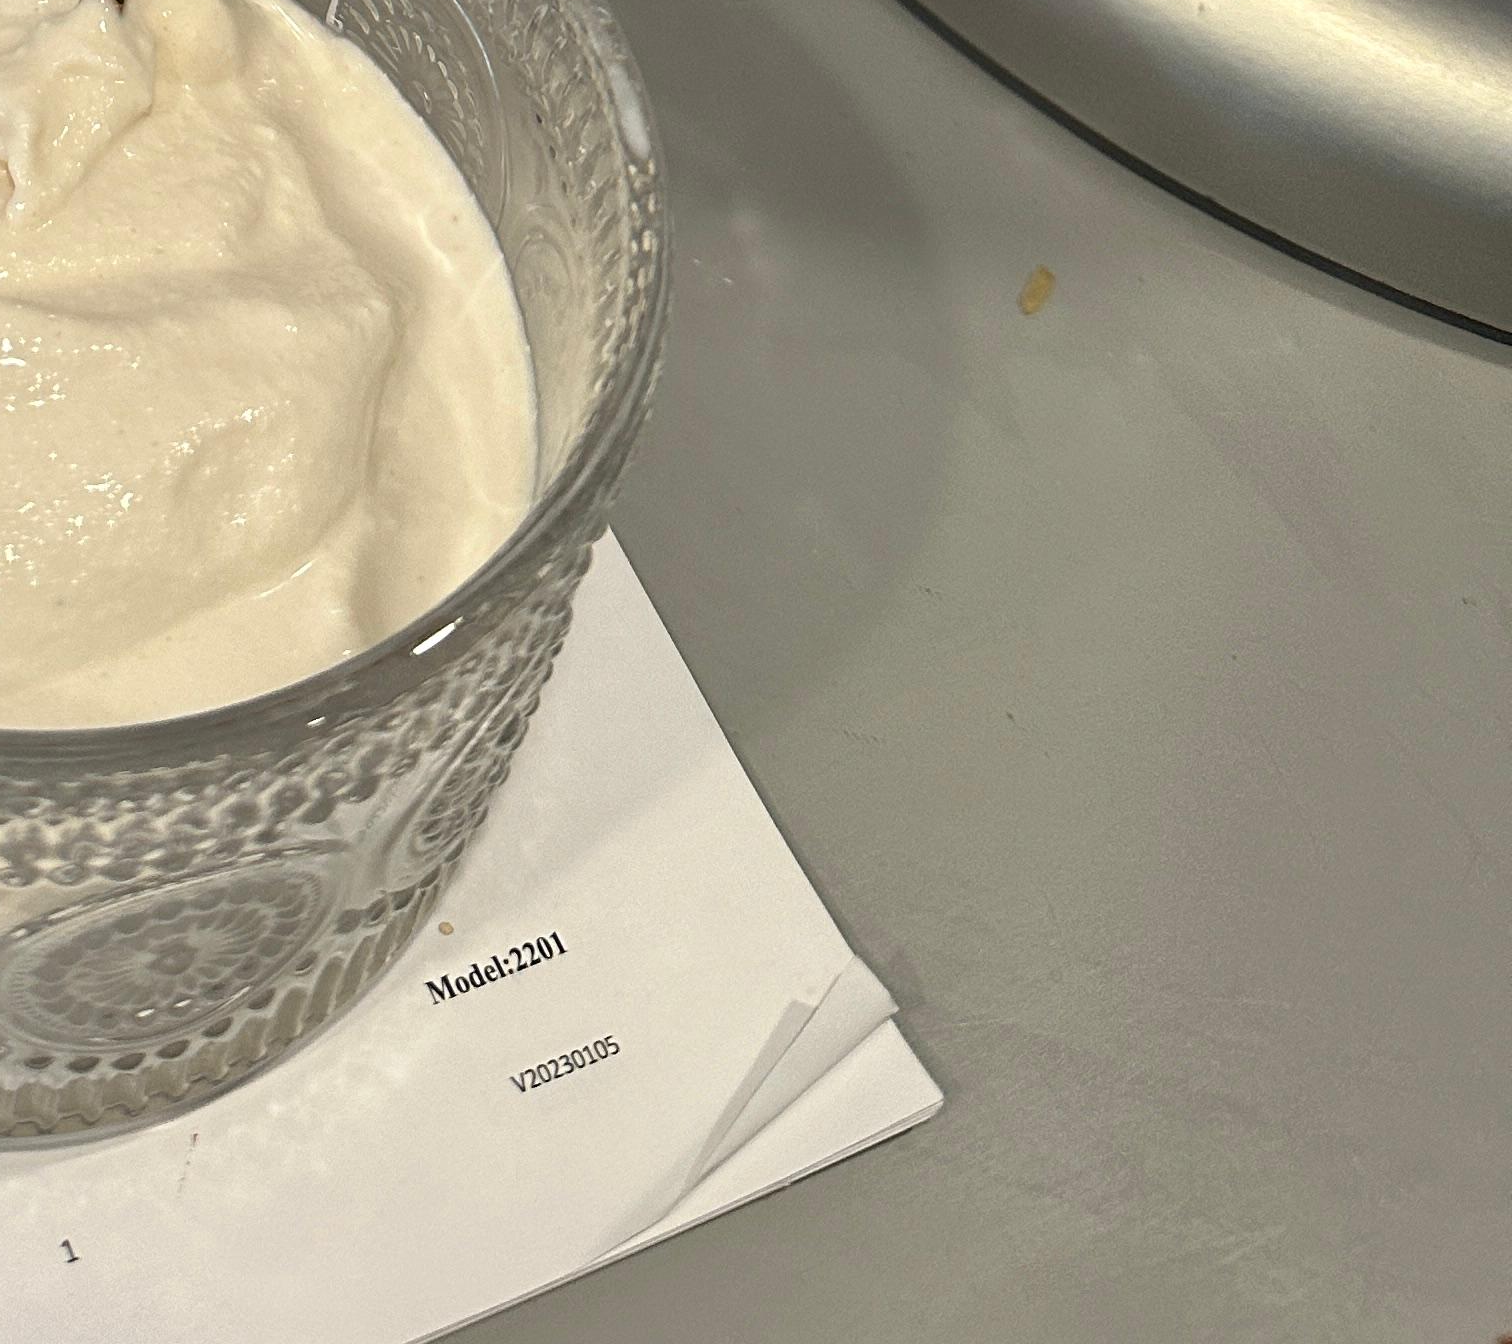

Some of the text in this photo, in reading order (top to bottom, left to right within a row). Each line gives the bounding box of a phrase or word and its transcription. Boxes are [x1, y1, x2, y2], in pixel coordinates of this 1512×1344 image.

[424, 931, 568, 1005] Model:2201
[510, 1034, 622, 1094] V20230105
[59, 1239, 80, 1264] 1
